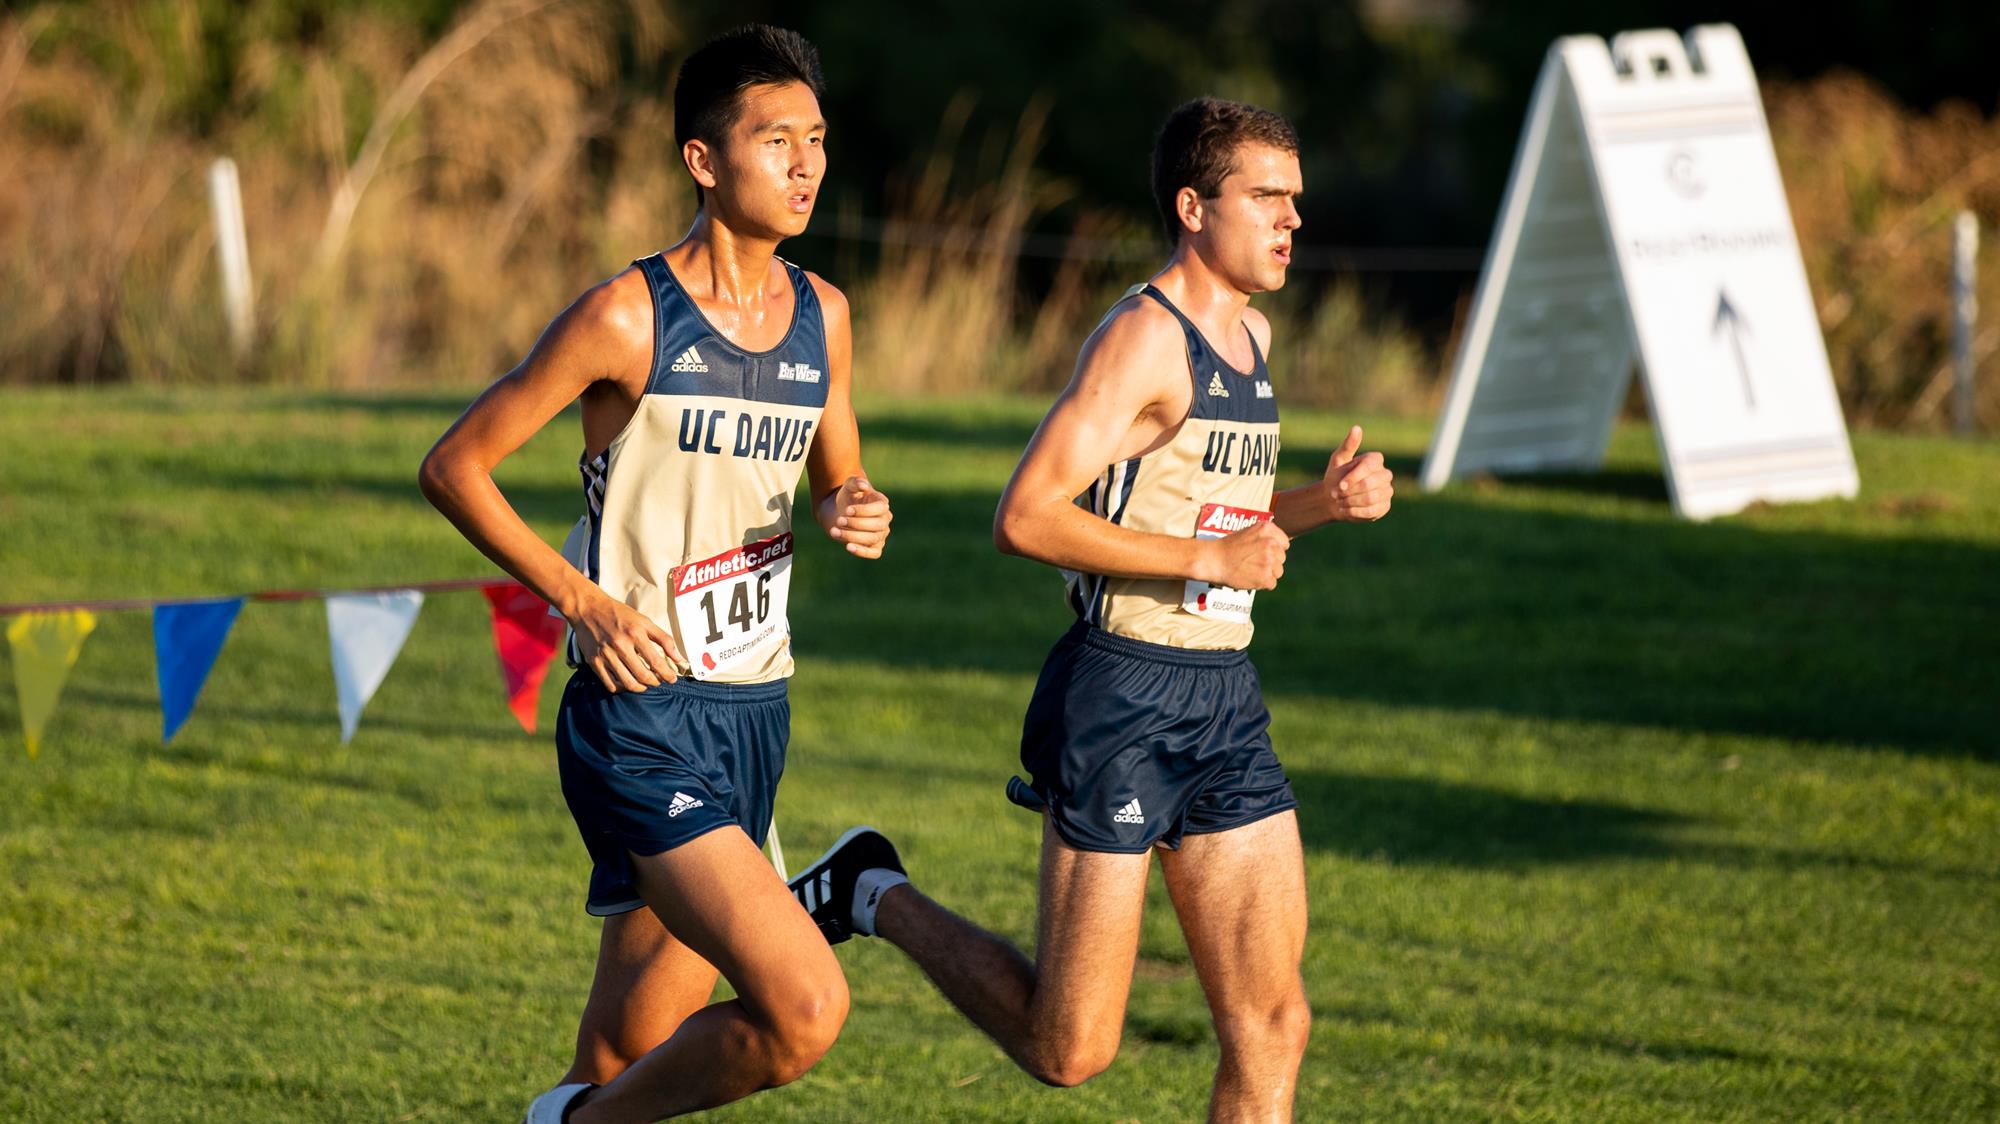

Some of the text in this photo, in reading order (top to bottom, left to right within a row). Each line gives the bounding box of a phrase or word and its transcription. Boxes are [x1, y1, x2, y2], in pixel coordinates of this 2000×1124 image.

[671, 362, 709, 373] adidas
[678, 408, 813, 462] UC DAVIS
[1202, 431, 1280, 476] UC DAVI
[678, 536, 789, 592] Athletic.net
[700, 571, 772, 645] 146
[668, 800, 704, 818] adidas
[1113, 814, 1145, 825] adidas
